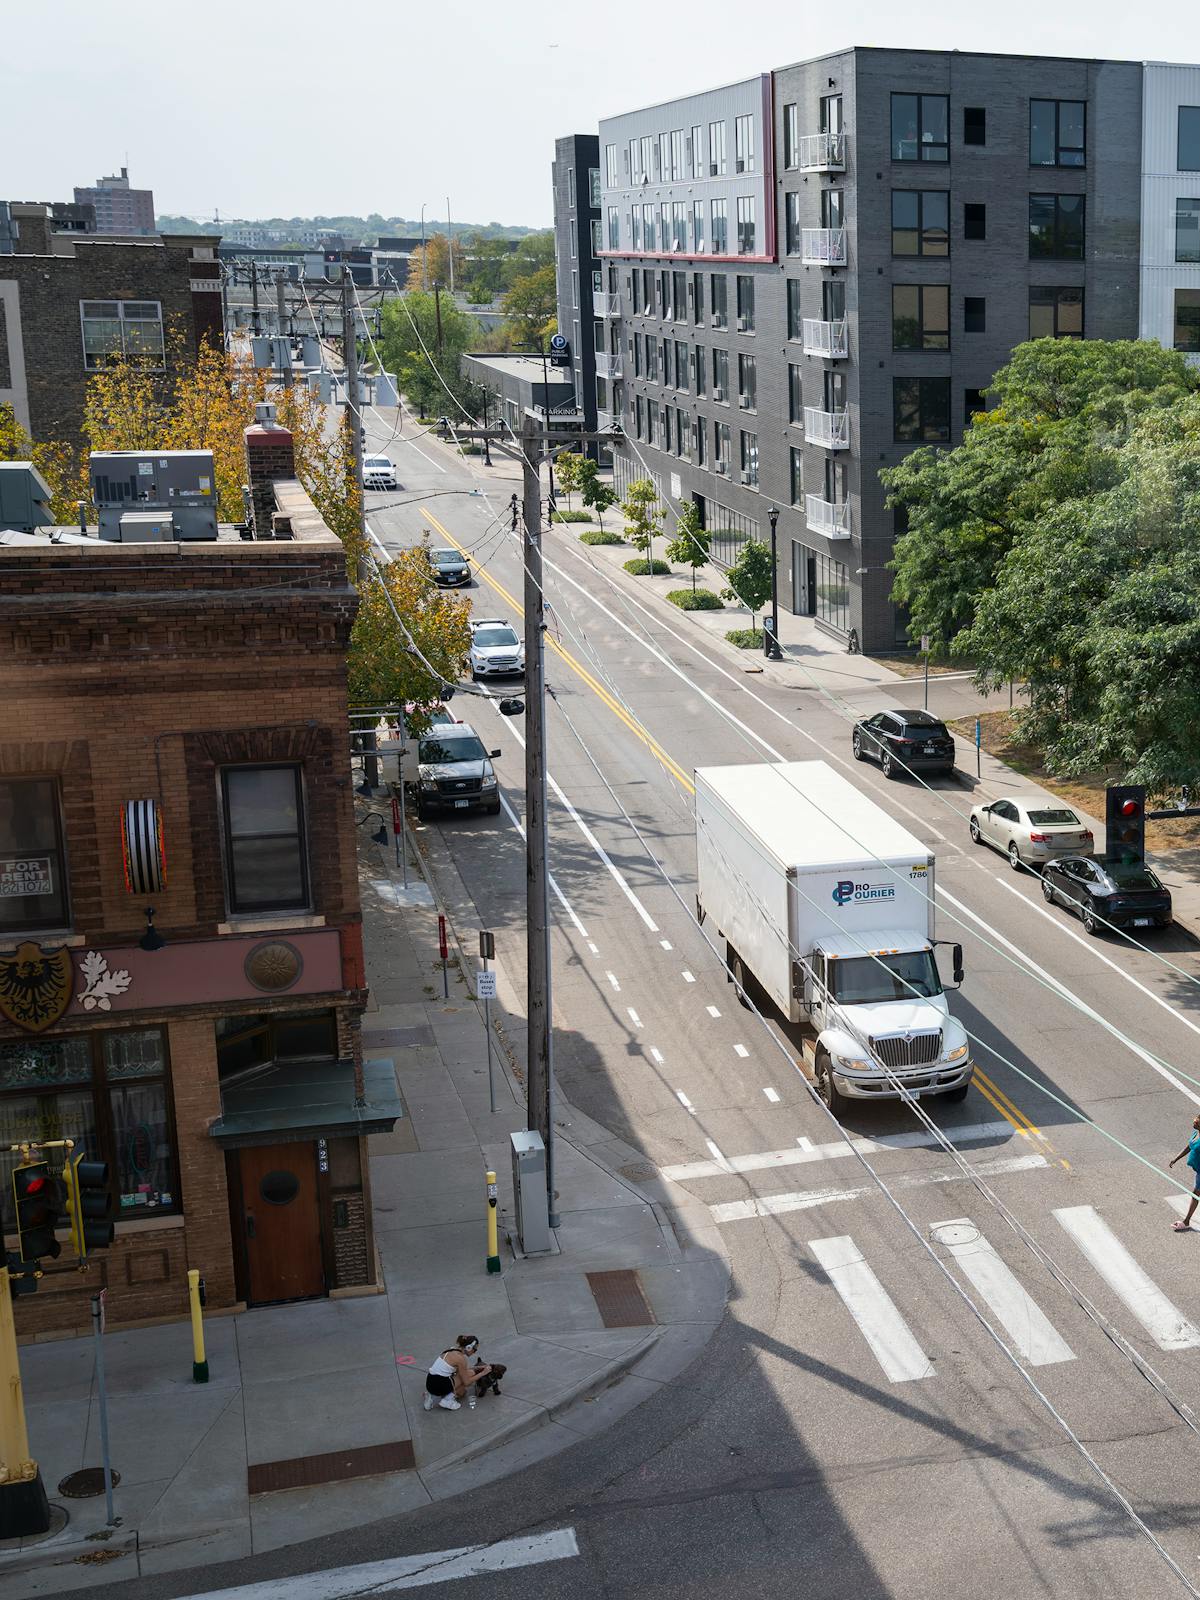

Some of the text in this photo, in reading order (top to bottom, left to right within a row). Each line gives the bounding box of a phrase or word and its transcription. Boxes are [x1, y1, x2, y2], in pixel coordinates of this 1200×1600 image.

[543, 408, 577, 416] PARKING
[5, 861, 41, 873] FOR
[1, 870, 47, 882] RENT
[319, 1138, 328, 1171] 923
